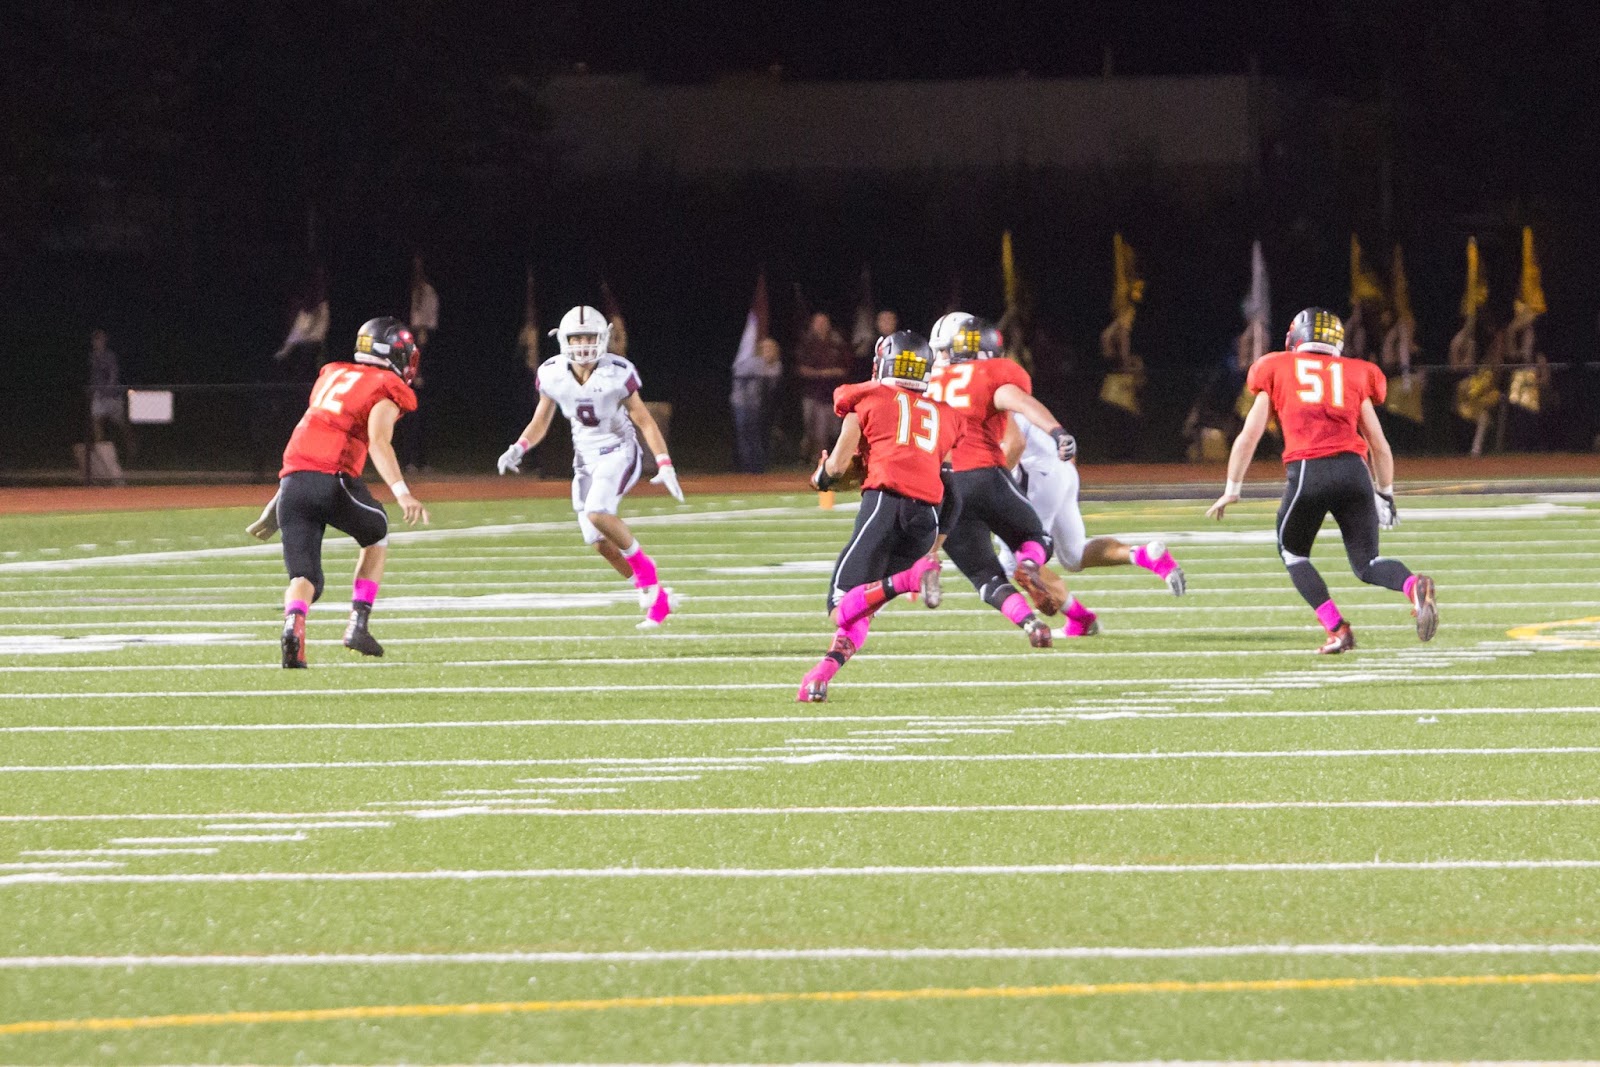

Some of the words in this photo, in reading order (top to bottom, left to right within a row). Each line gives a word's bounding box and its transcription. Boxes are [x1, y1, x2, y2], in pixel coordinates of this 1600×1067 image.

[311, 368, 363, 414] 12
[1294, 357, 1344, 407] 51
[896, 391, 939, 454] 13
